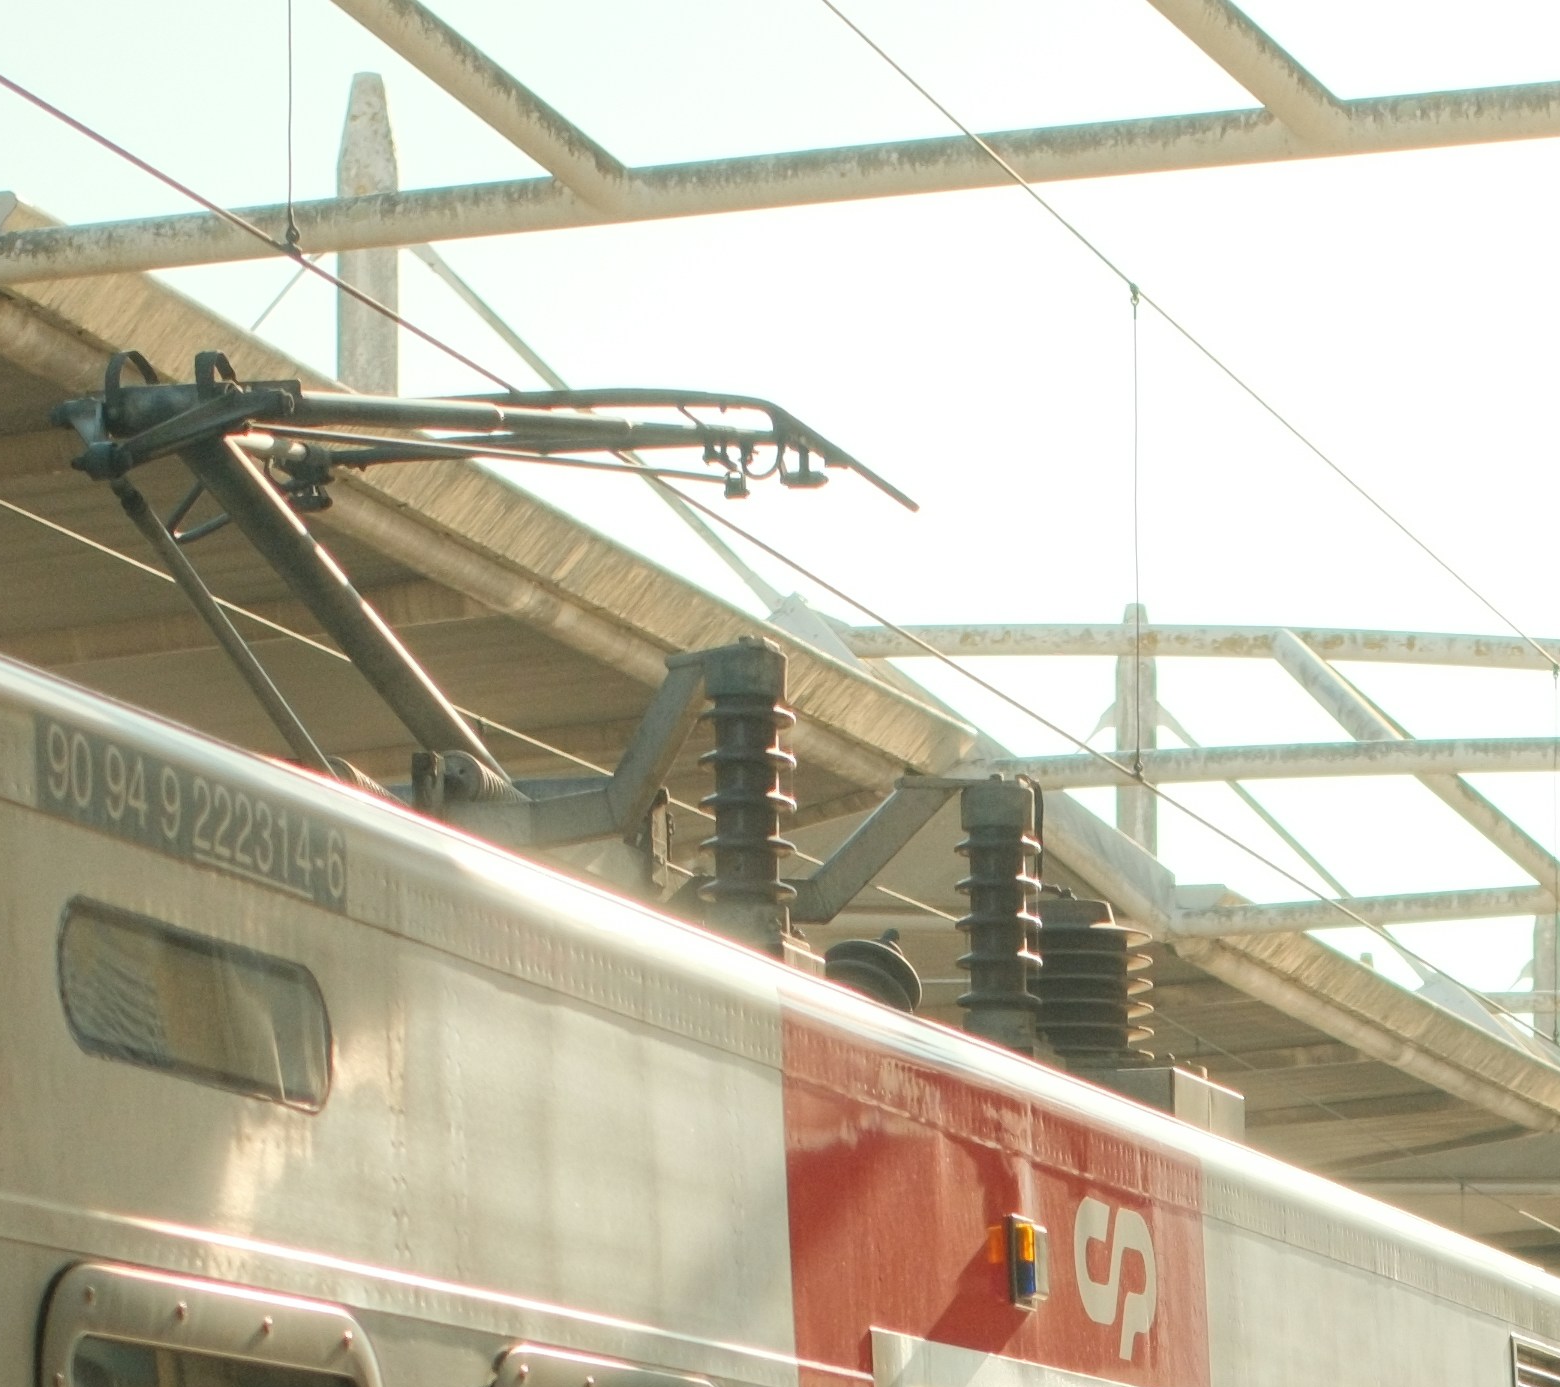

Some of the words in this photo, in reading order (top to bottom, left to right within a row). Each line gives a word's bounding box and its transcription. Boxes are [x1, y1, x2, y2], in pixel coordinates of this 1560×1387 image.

[46, 723, 93, 808] 90
[105, 744, 147, 827] 94
[160, 766, 181, 839] 9
[192, 776, 344, 899] 222314-6
